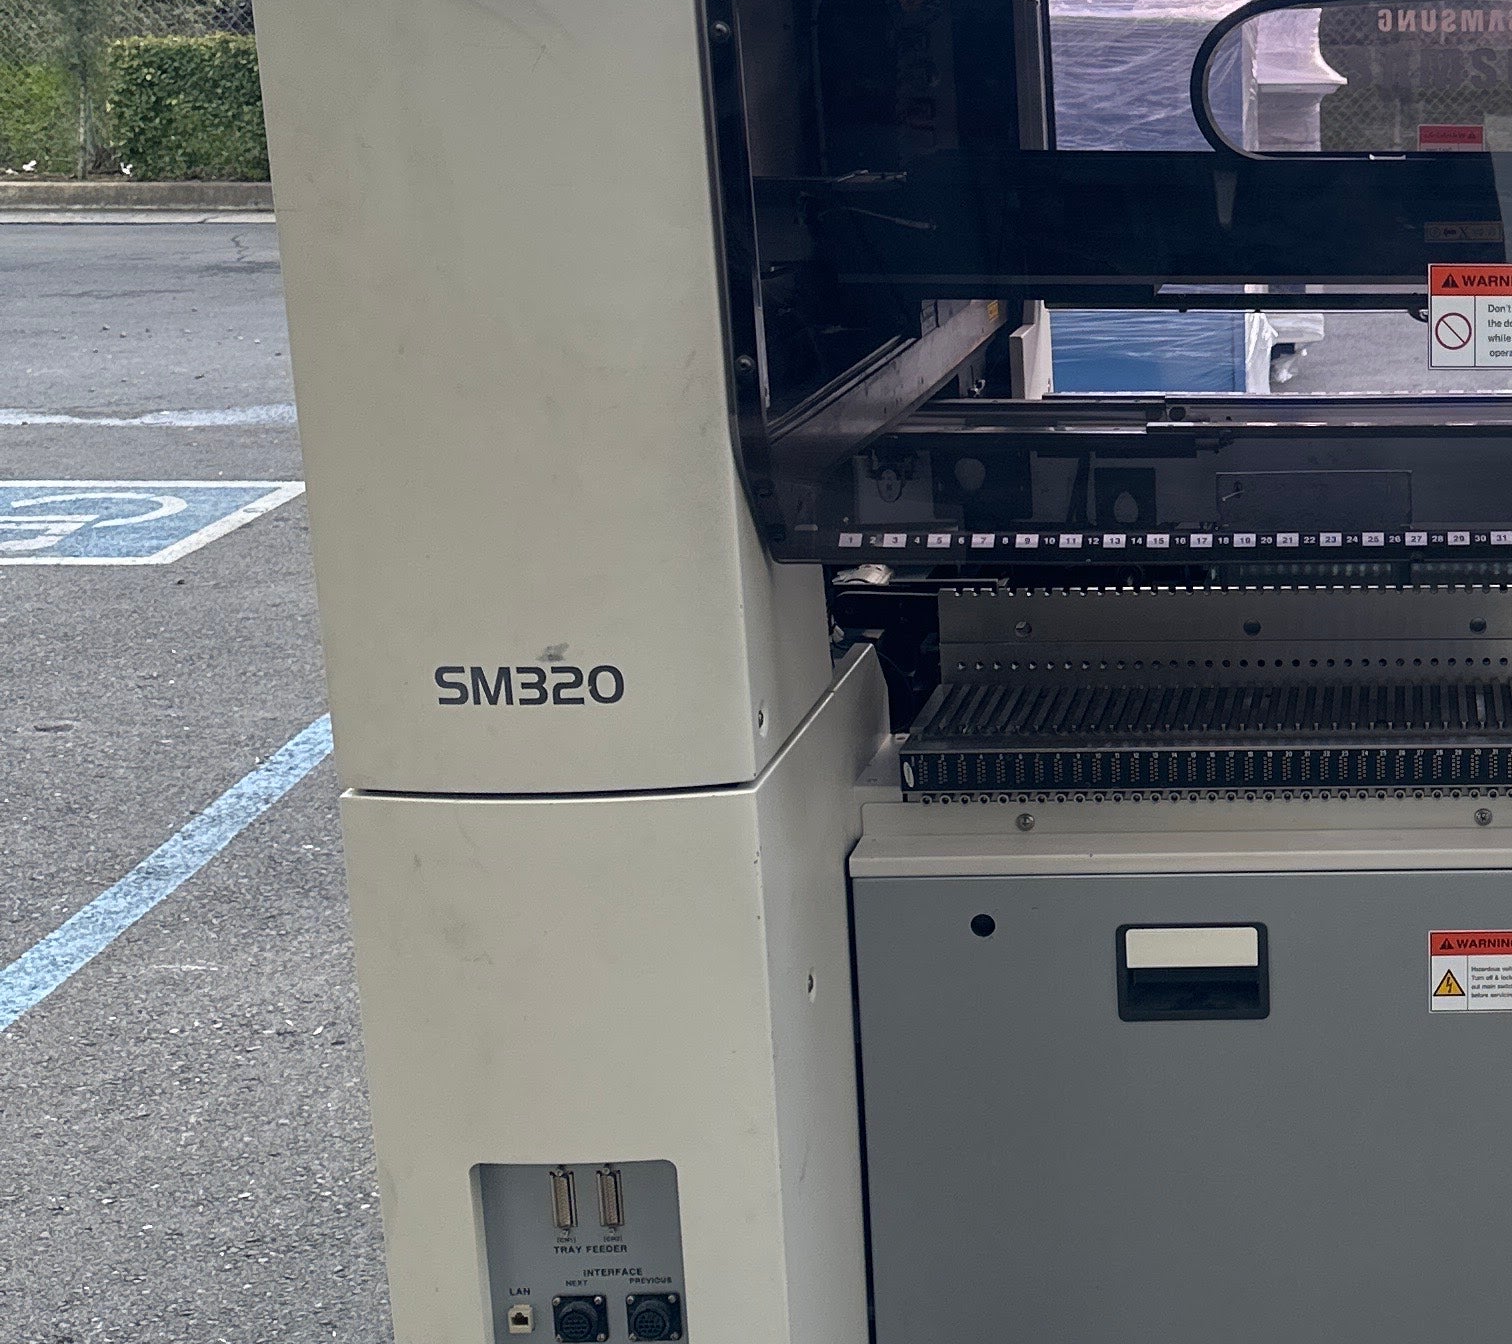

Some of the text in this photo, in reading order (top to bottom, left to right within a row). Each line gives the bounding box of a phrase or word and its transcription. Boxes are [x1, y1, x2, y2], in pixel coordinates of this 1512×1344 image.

[1488, 304, 1511, 312] Don't
[1488, 320, 1502, 328] the
[1488, 334, 1511, 342] while
[434, 665, 624, 706] SM320
[554, 1245, 628, 1254] TRAY FEEDER
[583, 1268, 642, 1276] INTERFACE
